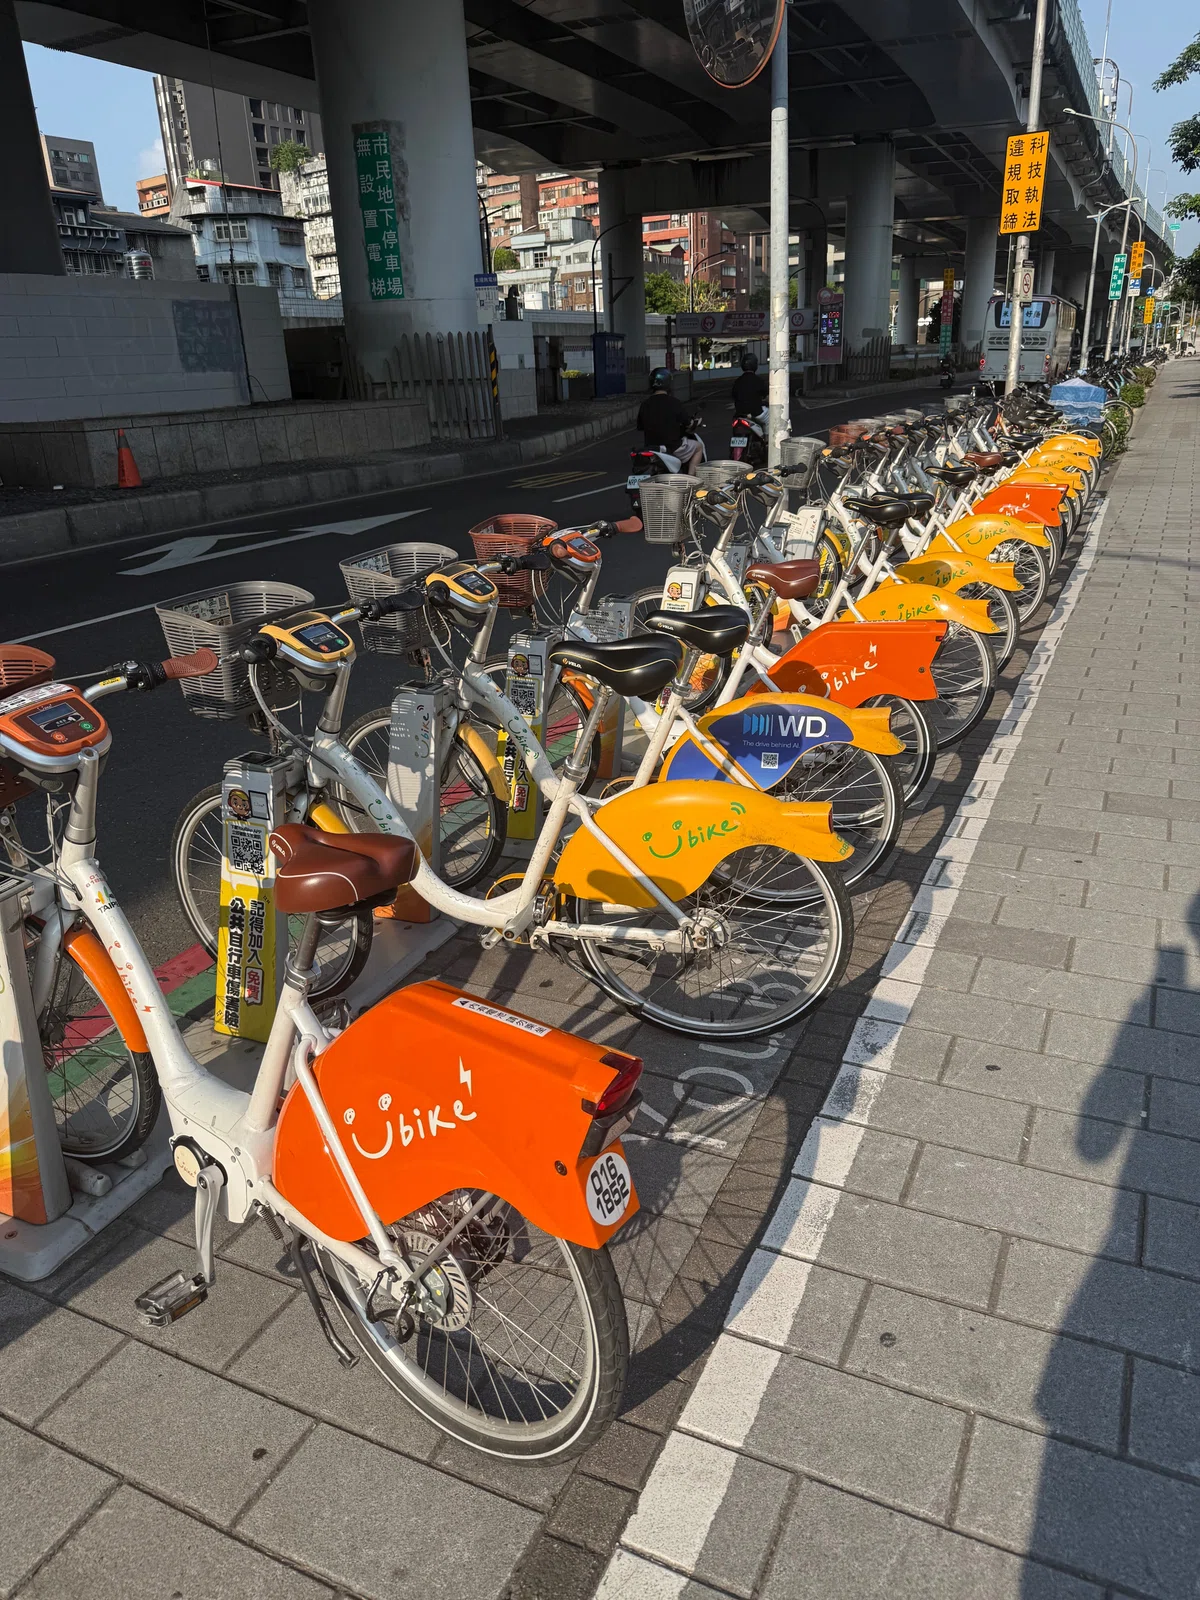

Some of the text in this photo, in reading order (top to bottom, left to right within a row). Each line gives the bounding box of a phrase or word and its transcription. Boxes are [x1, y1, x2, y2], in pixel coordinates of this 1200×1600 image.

[372, 132, 403, 296] 市民地下停車場
[1002, 139, 1025, 230] 違規取締
[1022, 136, 1046, 228] 科技執法
[356, 138, 386, 296] 無設置電梯
[755, 740, 770, 748] drive
[771, 741, 791, 749] behind
[778, 715, 827, 738] WD
[225, 898, 245, 1028] 公共自行車傷害險
[248, 900, 264, 965] 記得加入
[247, 970, 260, 1000] 免費
[590, 1155, 618, 1196] 016
[596, 1173, 630, 1219] 1852
